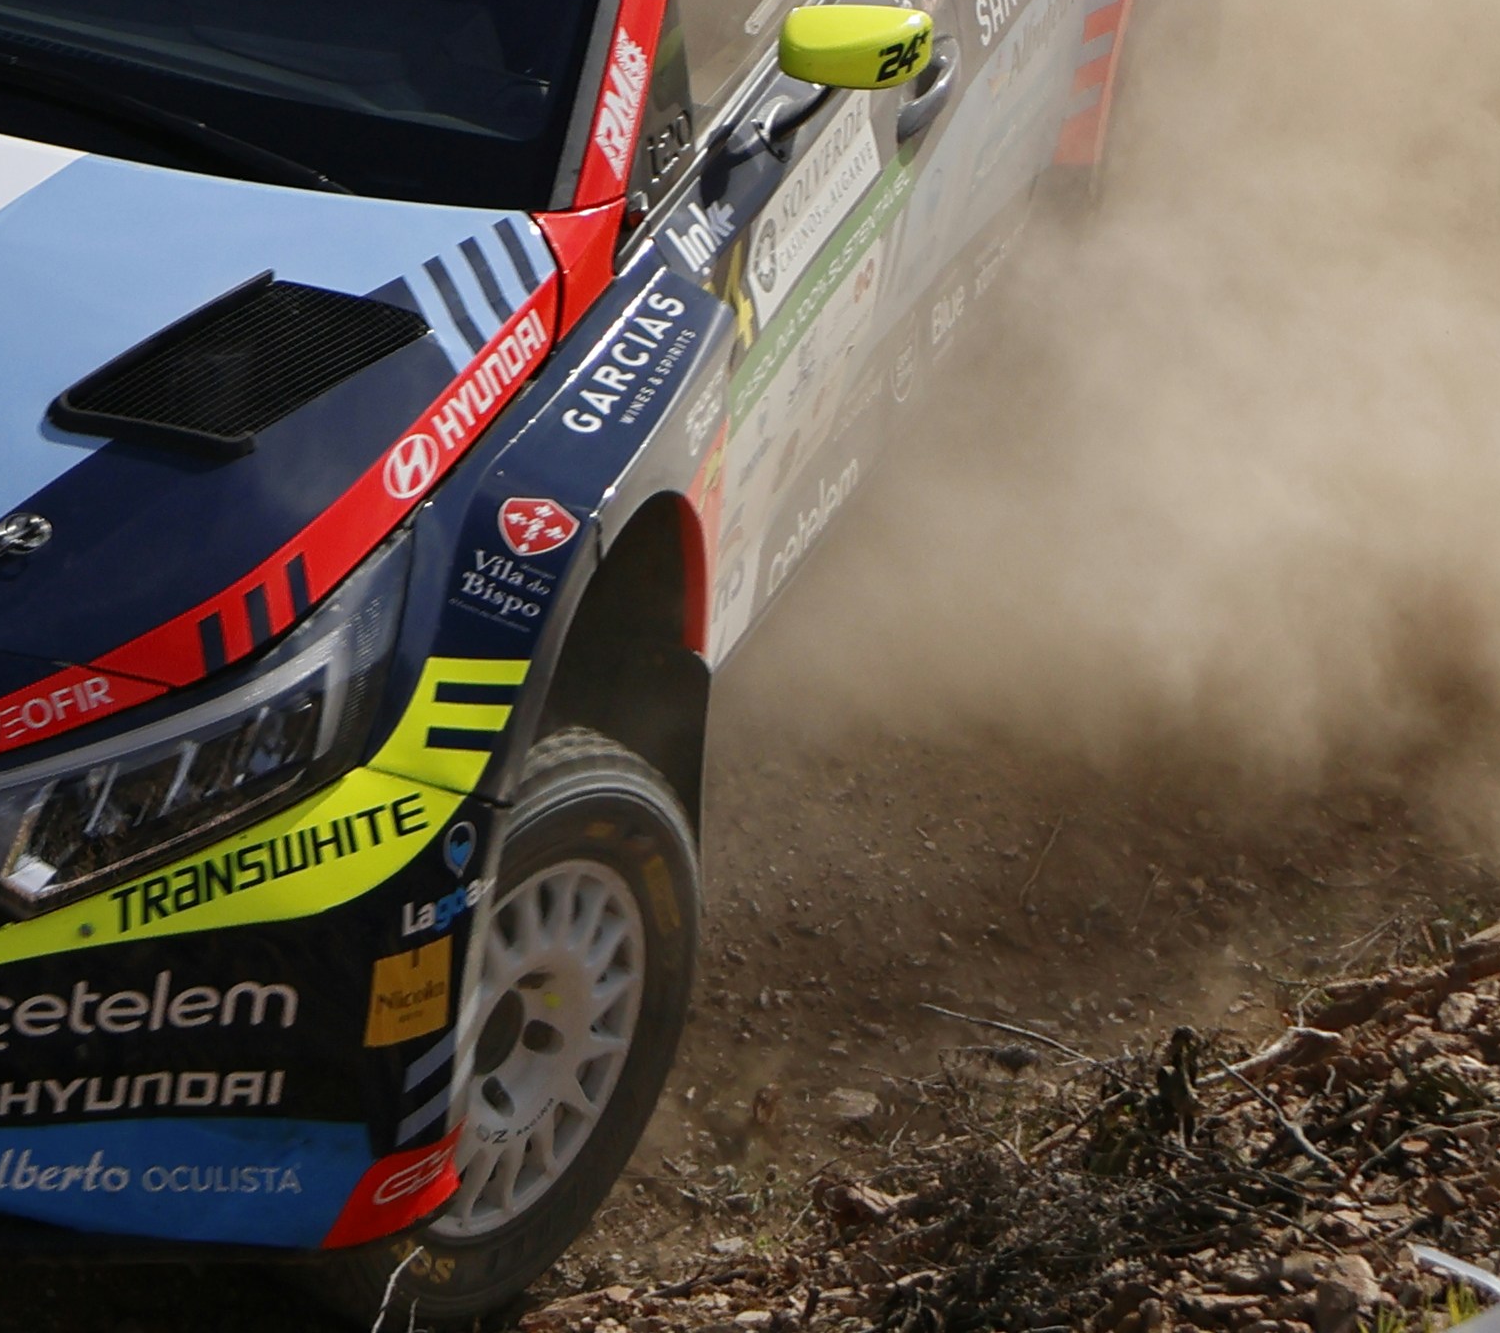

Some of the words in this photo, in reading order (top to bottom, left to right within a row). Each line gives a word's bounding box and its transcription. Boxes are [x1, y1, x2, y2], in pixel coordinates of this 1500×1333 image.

[562, 293, 686, 434] GARCIAS
[654, 328, 697, 377] SPIRITS
[431, 308, 547, 454] HYUNDAI
[647, 376, 664, 387] &
[618, 386, 657, 424] WINES
[474, 549, 524, 586] Vila
[460, 571, 540, 617] Bispo
[141, 1163, 303, 1196] OCULISTA
